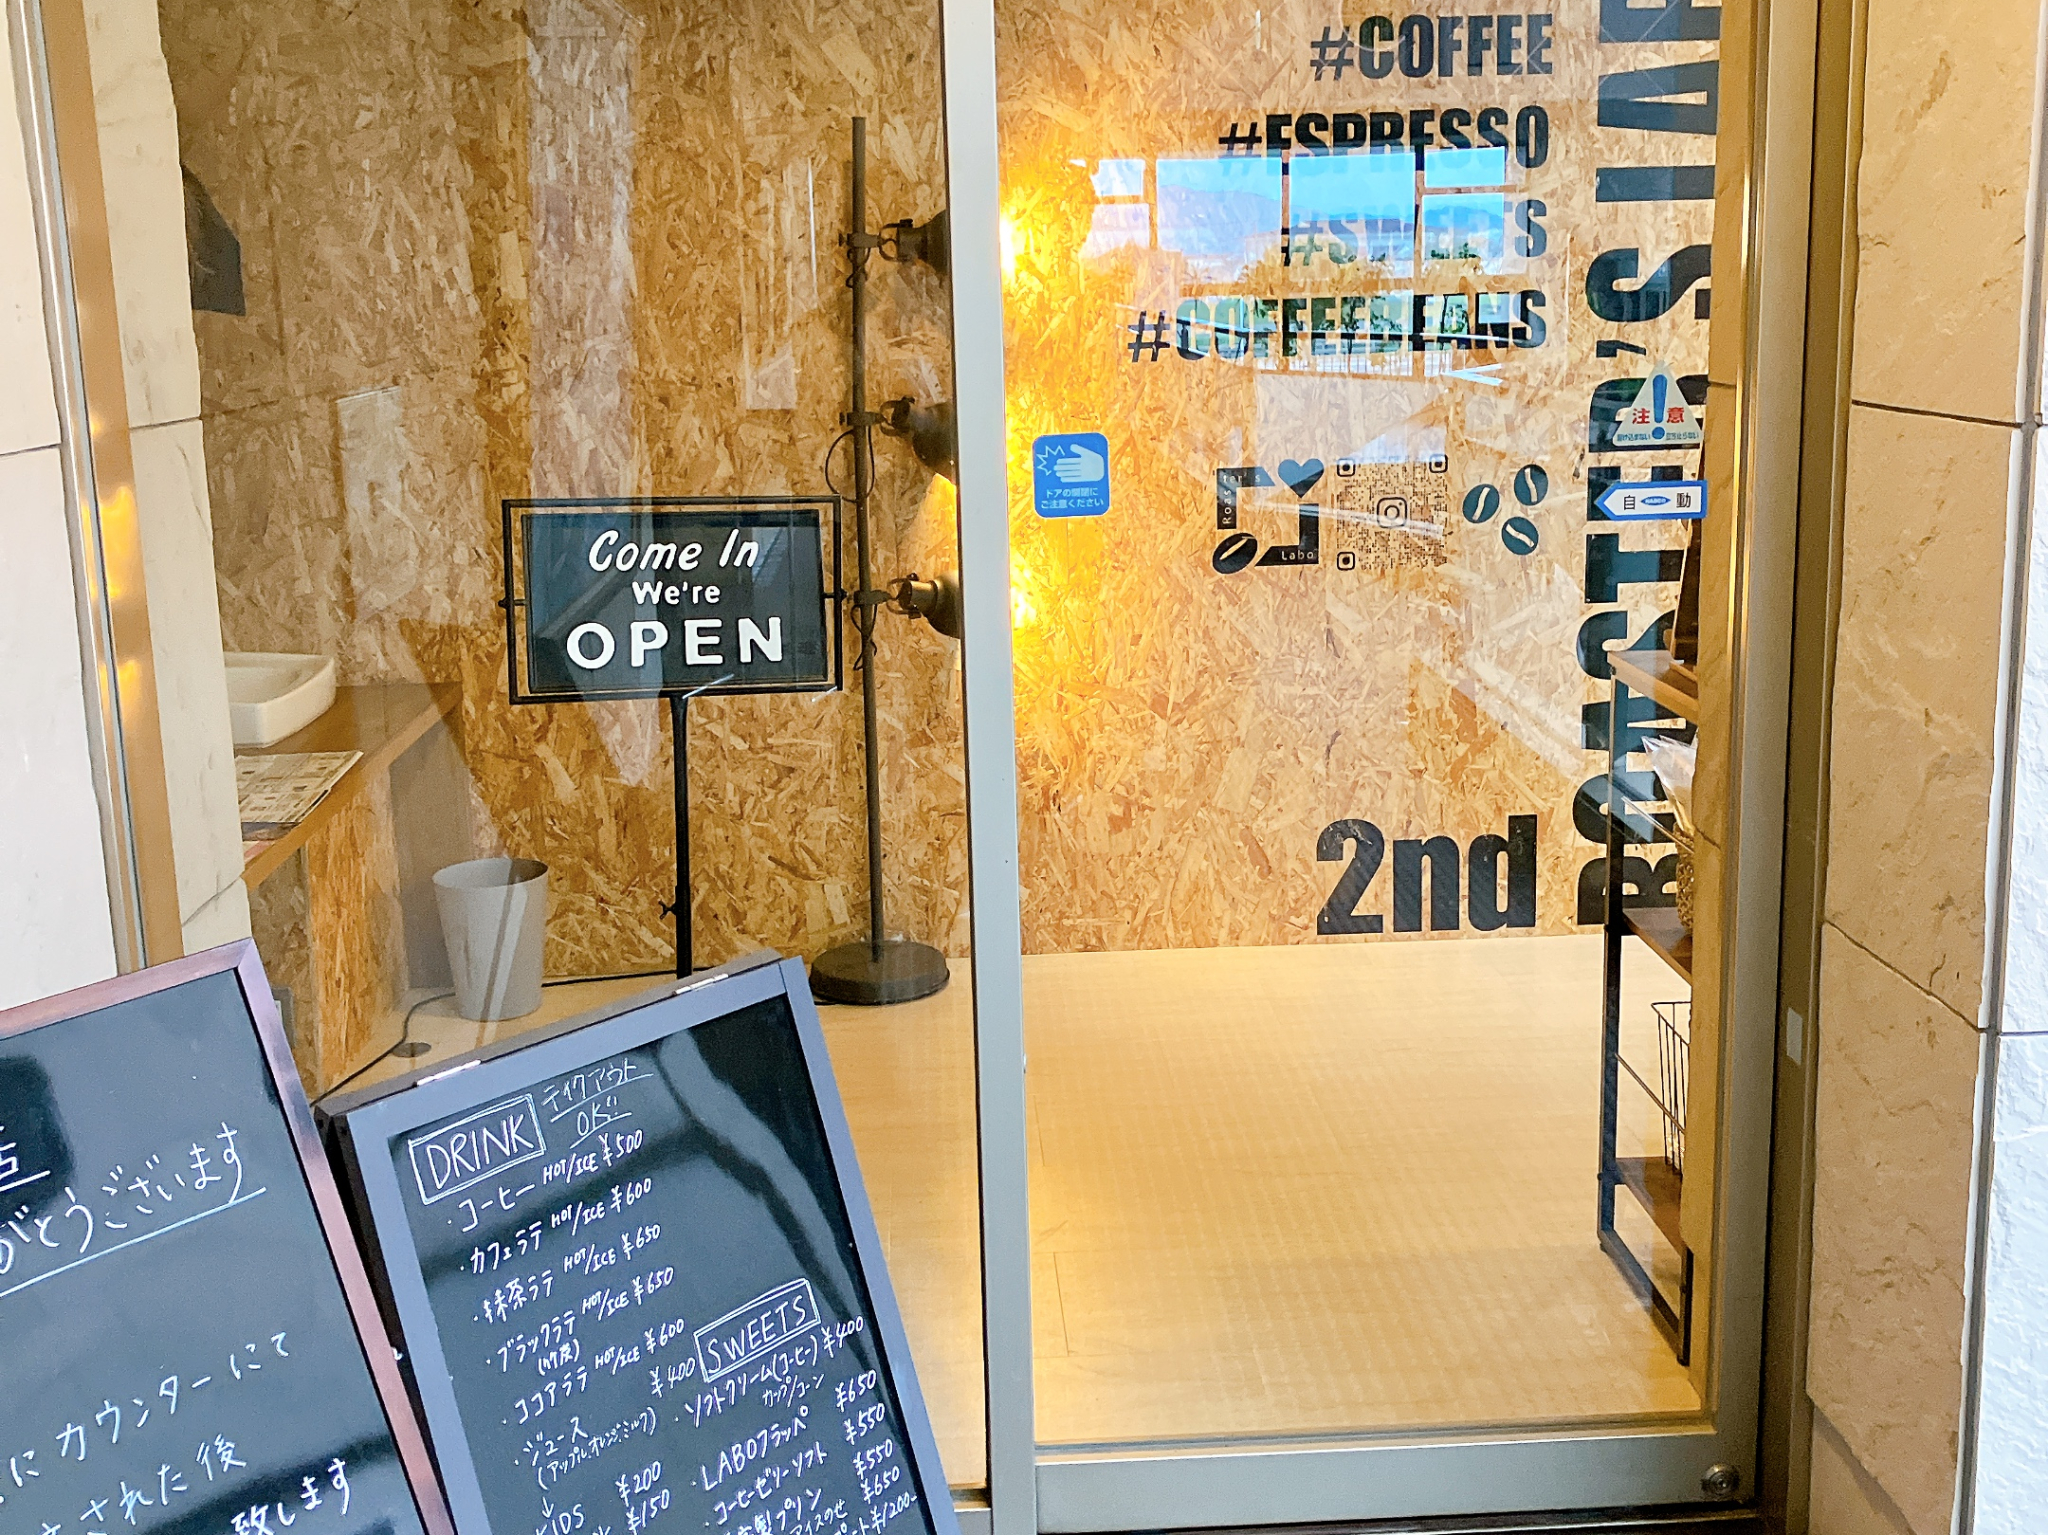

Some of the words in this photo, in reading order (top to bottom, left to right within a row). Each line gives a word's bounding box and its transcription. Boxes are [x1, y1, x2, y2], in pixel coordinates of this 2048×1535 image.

[1310, 13, 1553, 81] #COFFEE
[1218, 105, 1549, 178] #ESPRESSO
[1127, 289, 1547, 363] #COFFEEBEANS
[589, 529, 702, 571] Come
[719, 528, 759, 567] In
[632, 581, 721, 604] We're
[567, 616, 783, 669] OPEN
[1316, 813, 1537, 935] 2nd
[426, 1114, 534, 1190] DRINK
[707, 1294, 806, 1374] SWEETS
